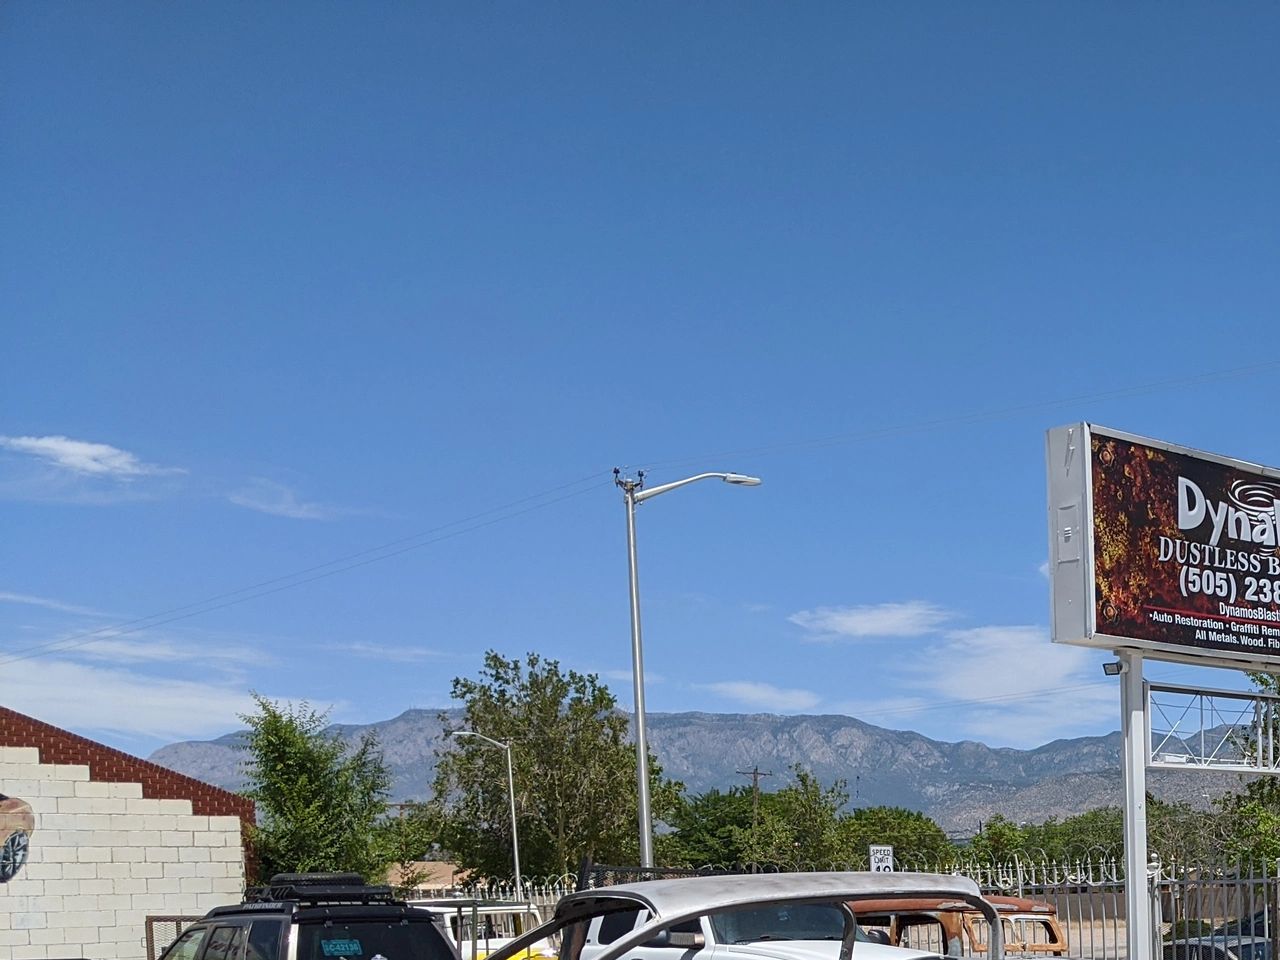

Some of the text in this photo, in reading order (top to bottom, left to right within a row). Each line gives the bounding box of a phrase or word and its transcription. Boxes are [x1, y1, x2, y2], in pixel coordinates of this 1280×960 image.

[1158, 536, 1261, 574] DUSTLESS
[1179, 566, 1237, 604] (505)
[1174, 614, 1224, 630] Restoration
[1230, 621, 1259, 635] Graffiti
[1195, 629, 1207, 640] All
